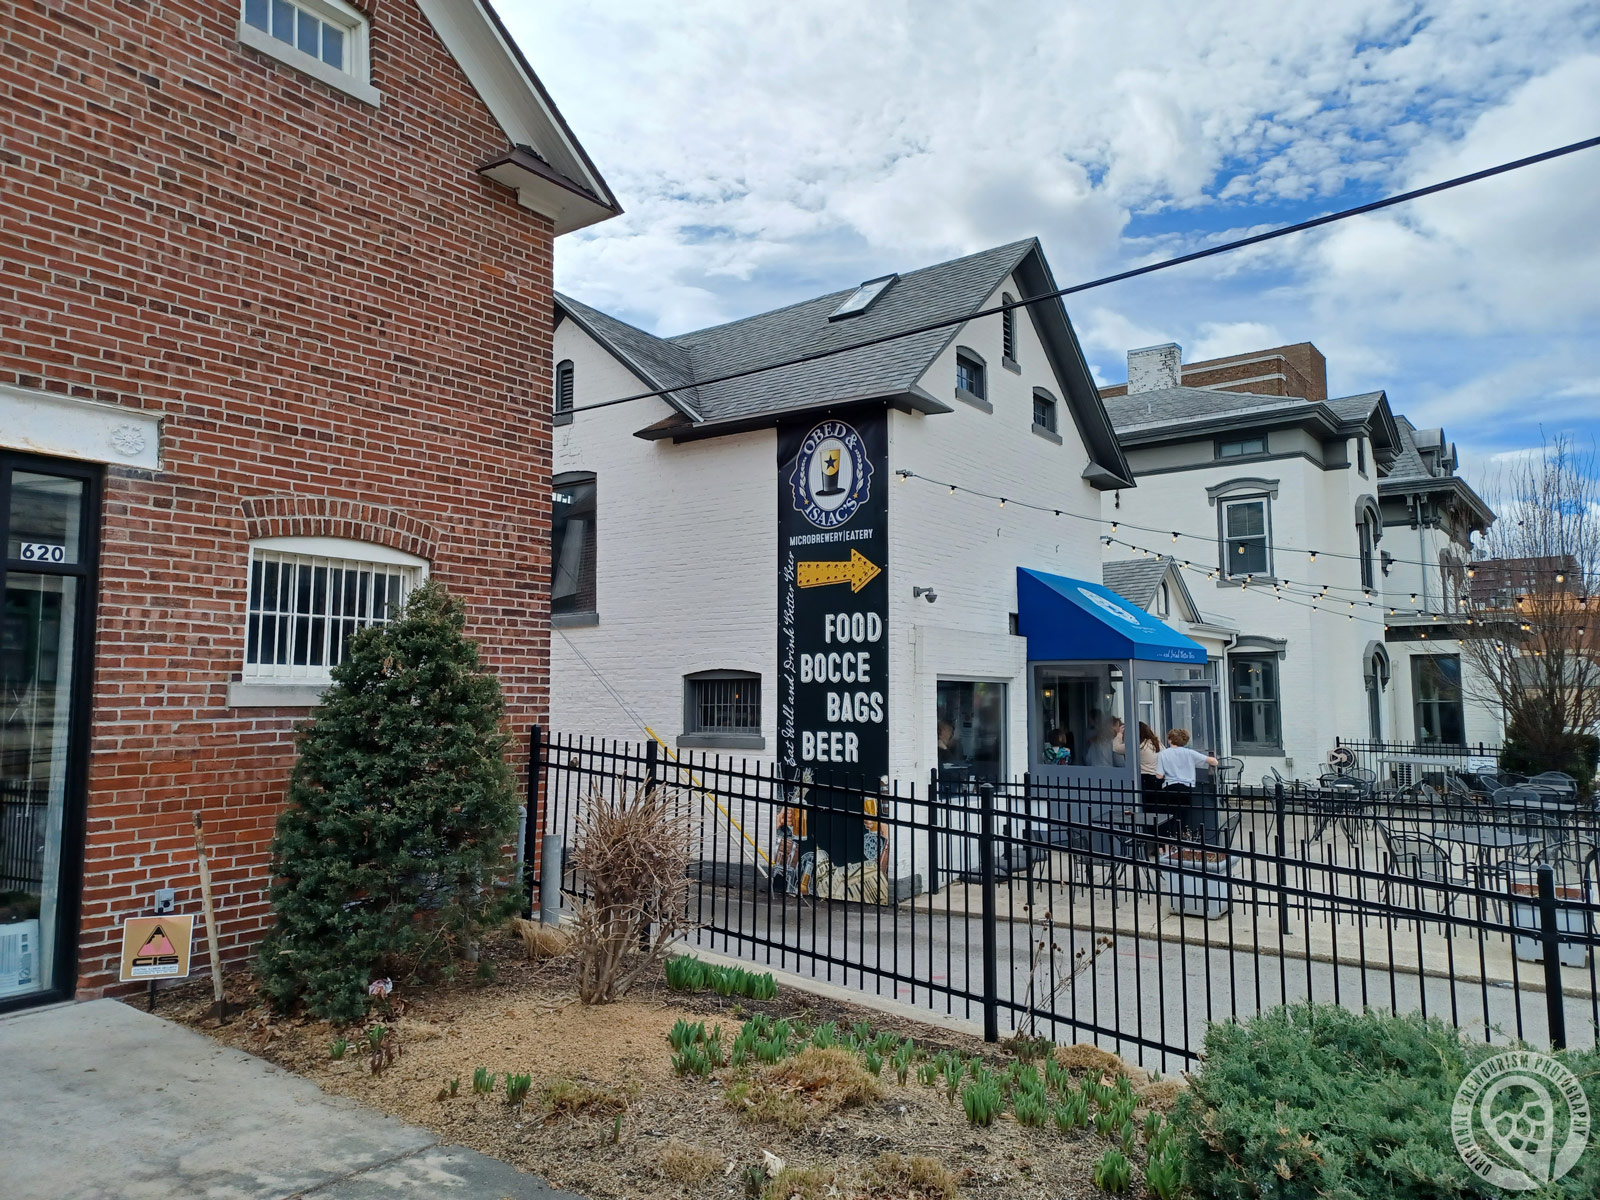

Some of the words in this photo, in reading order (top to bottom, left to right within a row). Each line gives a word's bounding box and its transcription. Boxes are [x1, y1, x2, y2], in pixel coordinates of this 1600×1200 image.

[804, 422, 846, 455] OBED
[845, 434, 858, 451] &
[804, 498, 857, 526] ISAAC'S
[22, 543, 64, 562] 620
[783, 550, 795, 582] Beer
[783, 583, 795, 625] Better
[825, 612, 882, 644] FOOD
[782, 627, 797, 674] Drink
[800, 652, 871, 684] BOCCE
[783, 673, 795, 705] and
[781, 704, 795, 739] Well
[827, 691, 884, 723] BAGS
[783, 740, 798, 767] Eat
[802, 731, 859, 763] BEER
[132, 955, 179, 967] CIS
